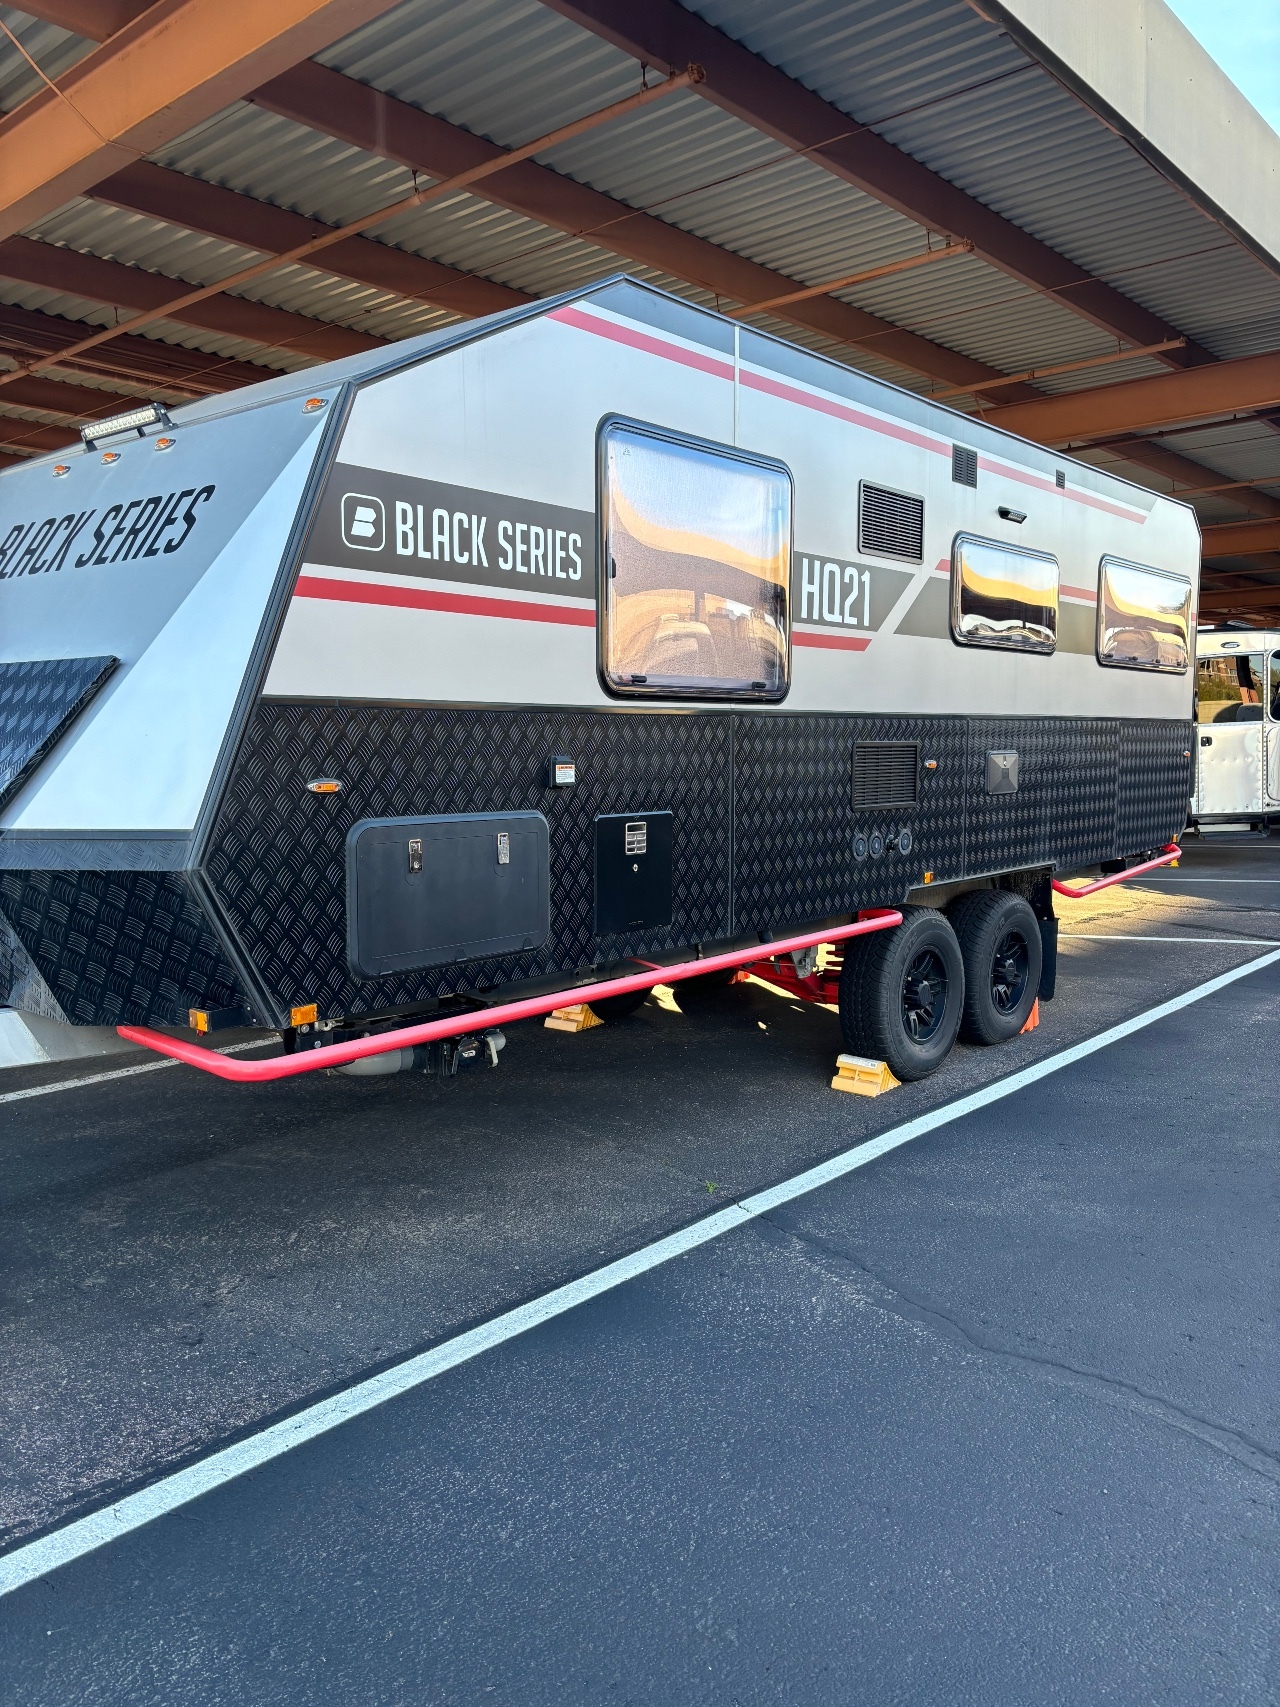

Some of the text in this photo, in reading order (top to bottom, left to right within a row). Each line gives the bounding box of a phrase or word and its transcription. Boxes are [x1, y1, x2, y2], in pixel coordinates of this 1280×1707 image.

[0, 484, 216, 580] BLACK SERIES
[395, 500, 489, 568] BLACK
[497, 519, 583, 581] SERIES
[801, 557, 871, 627] HQ21
